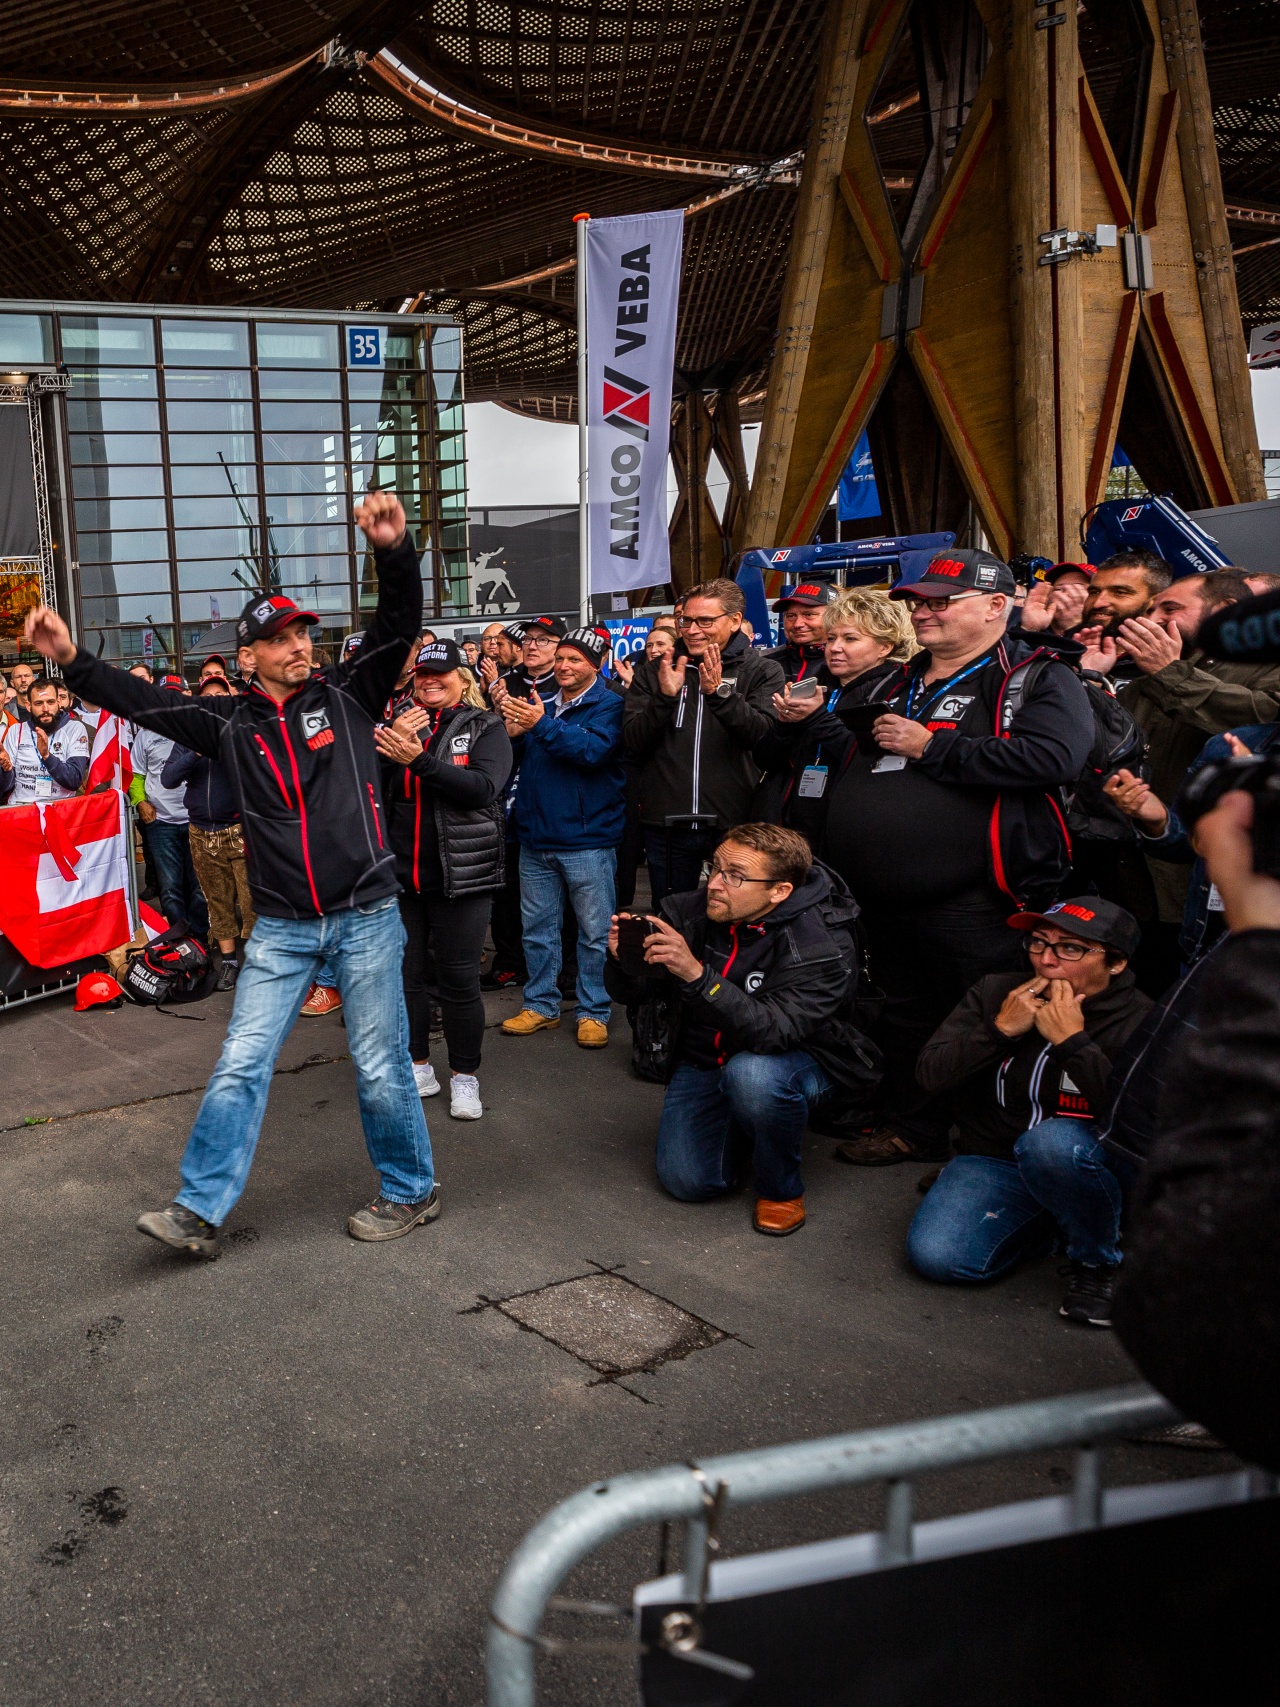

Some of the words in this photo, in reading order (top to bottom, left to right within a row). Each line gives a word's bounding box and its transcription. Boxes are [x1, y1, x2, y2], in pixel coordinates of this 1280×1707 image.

[614, 243, 651, 358] VEBA
[354, 334, 377, 359] 35
[609, 444, 641, 560] AMCO
[1180, 548, 1208, 573] AMCO
[437, 643, 447, 651] TO
[306, 728, 335, 751] HIAB
[1062, 904, 1096, 922] HIAB
[128, 971, 157, 996] PERFORM
[132, 963, 150, 980] BUILT
